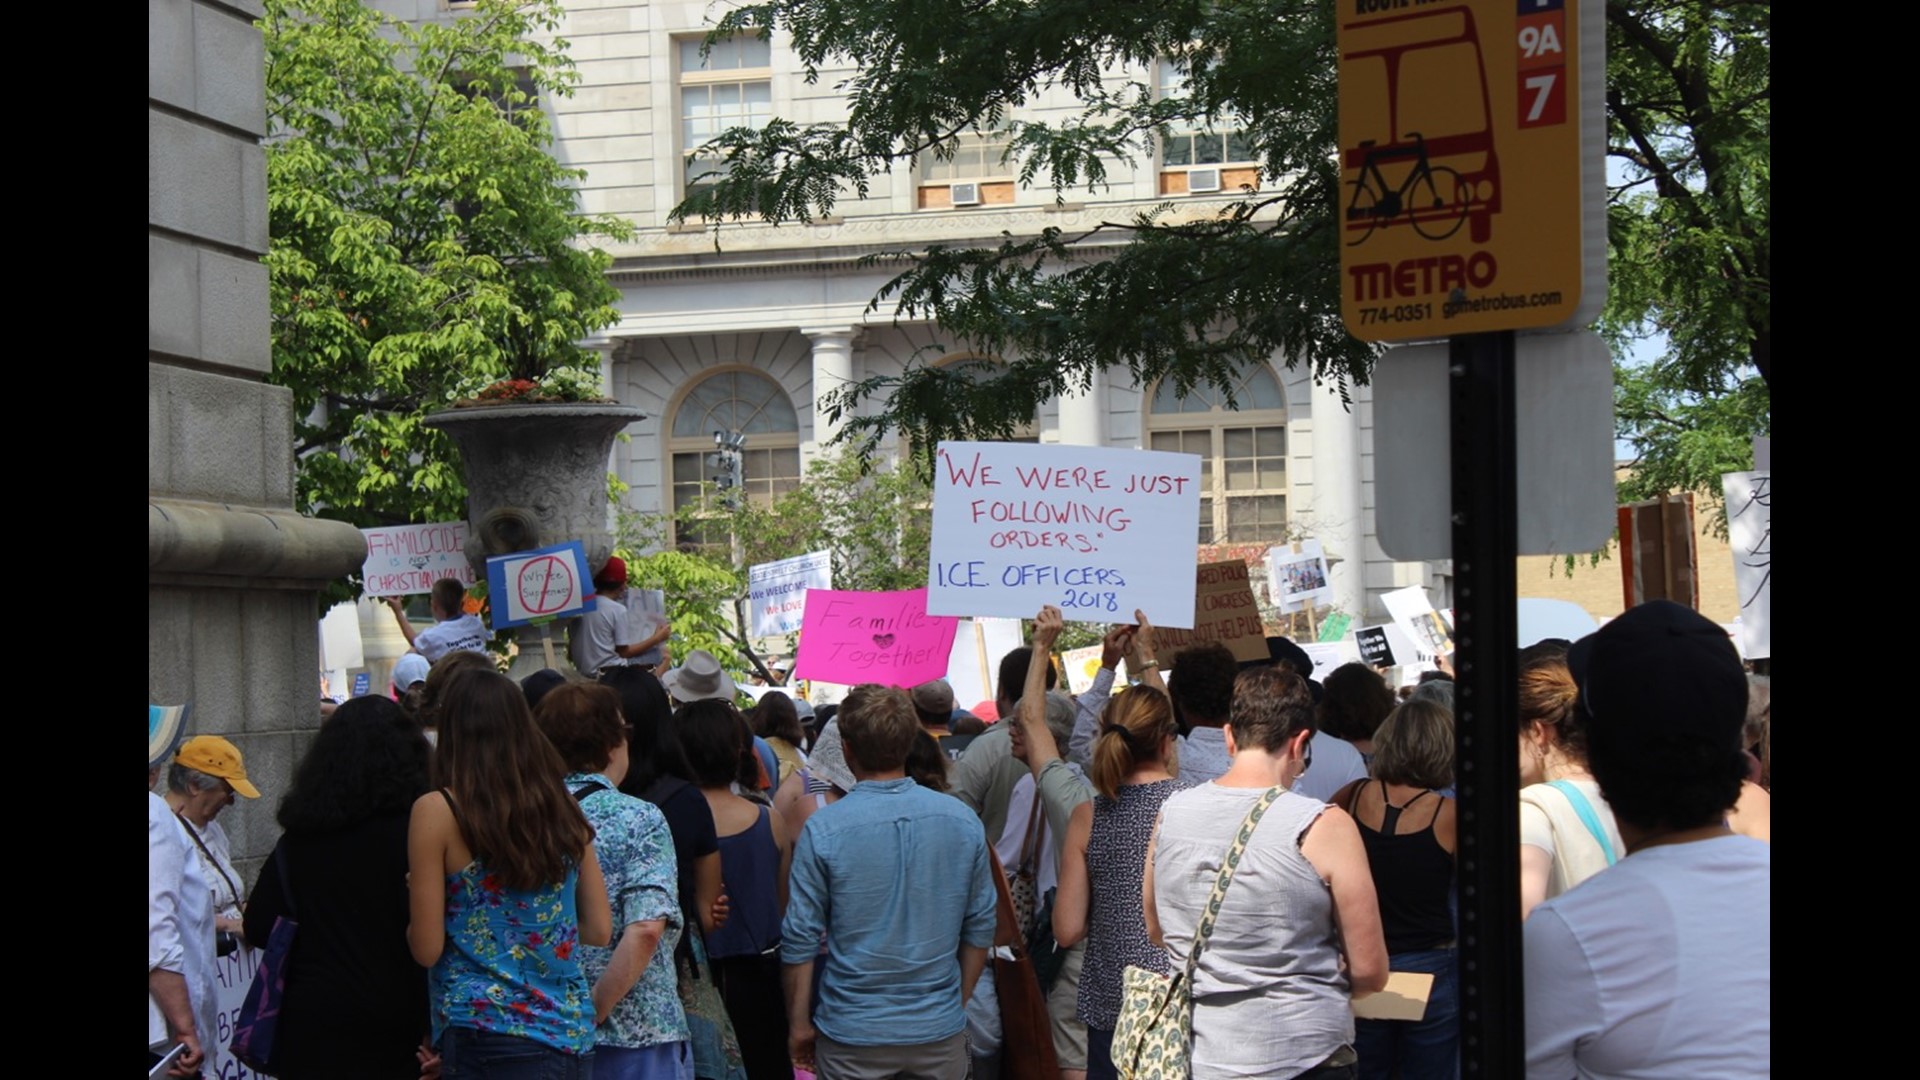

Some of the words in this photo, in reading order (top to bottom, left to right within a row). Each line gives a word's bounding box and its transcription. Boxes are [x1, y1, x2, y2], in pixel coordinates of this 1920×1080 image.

[1518, 24, 1562, 58] 9A
[1525, 74, 1556, 121] 7
[1348, 250, 1497, 302] METRO
[1360, 303, 1432, 325] 774-0351
[1442, 290, 1562, 319] gpmetrobus.com
[1016, 466, 1111, 493] WERE
[1124, 474, 1190, 495] JUST
[972, 499, 1132, 532] FOLLOWING
[368, 524, 465, 557] FAMILOCIDE
[408, 554, 431, 566] NOT
[367, 569, 434, 594] CHRISTIAN
[751, 590, 765, 600] We
[765, 579, 807, 598] WELCOME
[766, 605, 780, 616] We
[781, 598, 803, 613] LOVE
[1061, 589, 1119, 612] 2018
[1203, 590, 1252, 612] CONGRESS
[828, 626, 947, 669] Together!
[1158, 625, 1190, 650] WILL
[1215, 616, 1244, 641] HELP
[1245, 614, 1264, 636] US
